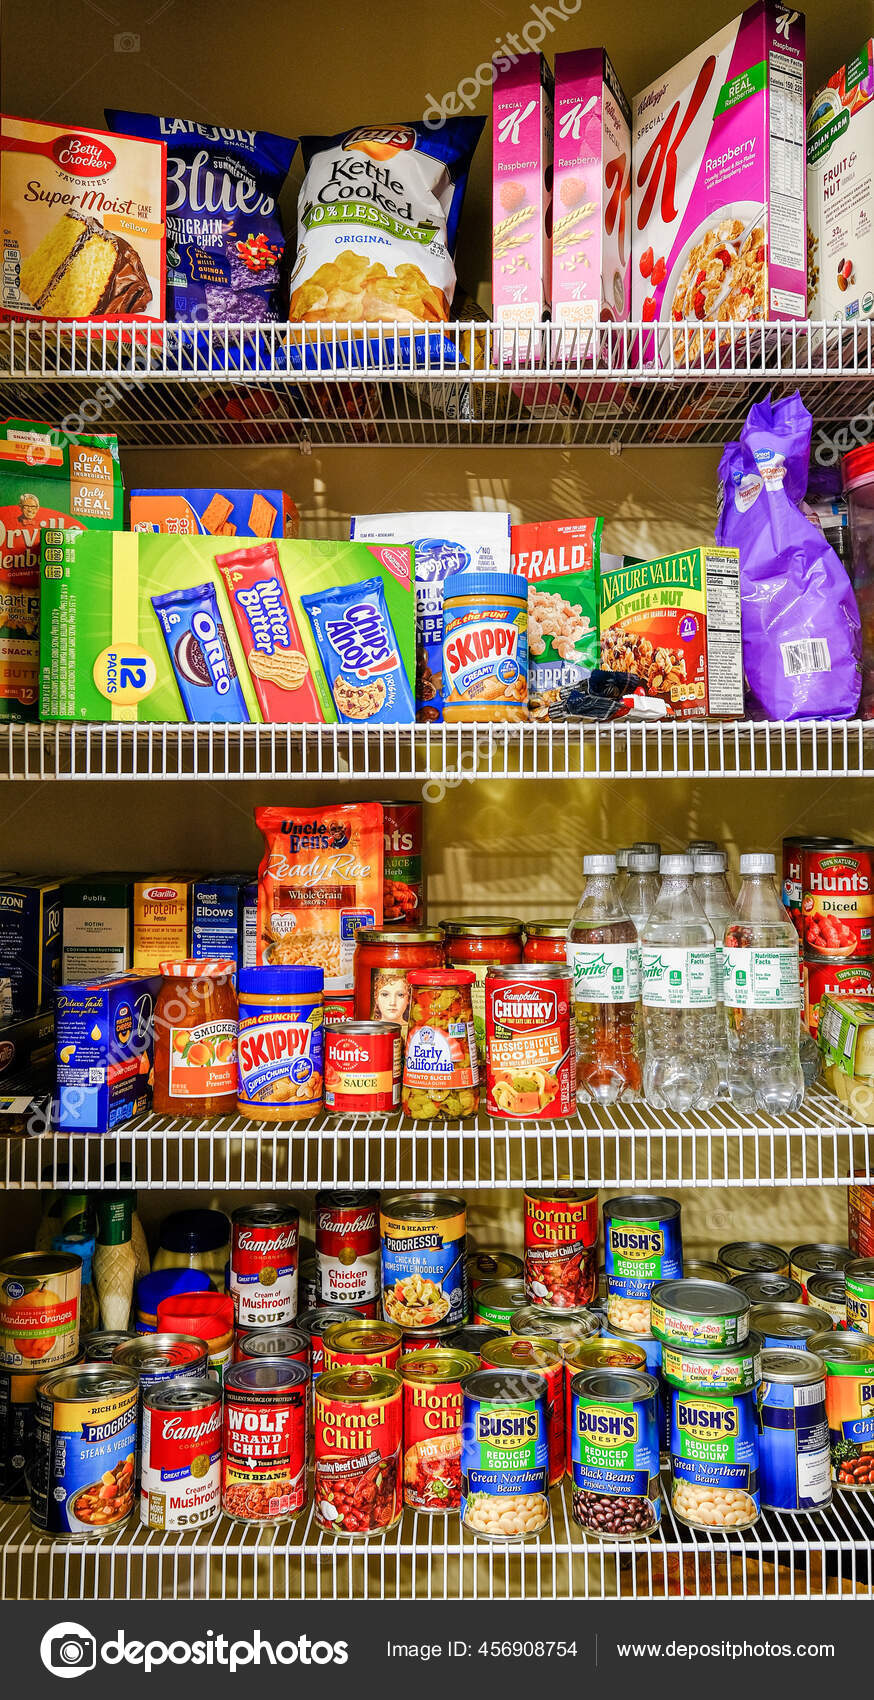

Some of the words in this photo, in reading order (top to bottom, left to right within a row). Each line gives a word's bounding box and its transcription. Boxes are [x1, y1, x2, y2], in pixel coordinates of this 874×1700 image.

[772, 39, 800, 56] Raspberry
[729, 78, 752, 98] REAL
[498, 102, 523, 110] SPECIAL
[559, 97, 584, 105] SPECIAL
[498, 101, 537, 144] K
[559, 96, 598, 140] K
[637, 112, 664, 140] SPECIAL
[830, 116, 848, 136] FARM
[69, 139, 104, 160] Betty
[224, 140, 255, 152] SNACKS
[58, 150, 109, 169] Crocker
[706, 136, 756, 173] Raspberry
[497, 160, 538, 171] Raspberry
[558, 156, 598, 168] Raspberry
[329, 157, 404, 195] Kettle
[823, 157, 847, 187] FRUIT
[57, 171, 108, 187] FAVORITES
[823, 180, 841, 202] NUT
[318, 183, 413, 221] Cooked
[119, 220, 149, 234] Yellow
[342, 204, 390, 226] LESS
[394, 223, 427, 241] FAT
[196, 236, 223, 249] CHIPS
[335, 234, 392, 246] ORIGINAL
[198, 266, 223, 275] QUINOA
[78, 453, 104, 465] Only
[73, 462, 110, 475] REAL
[79, 487, 104, 498] Only
[73, 497, 110, 510] REAL
[602, 566, 649, 603] NATURE
[649, 554, 697, 587] VALLEY
[615, 592, 650, 619] Fruit
[660, 590, 684, 607] NUT
[255, 578, 292, 648] Nutter
[481, 611, 509, 621] FUN!
[236, 589, 275, 655] Butter
[343, 604, 390, 661] Chips
[191, 612, 231, 696] OREO
[446, 628, 516, 674] SKIPPY
[107, 653, 117, 693] PACKS
[120, 657, 147, 689] 12
[462, 664, 494, 686] CREAMY
[384, 673, 400, 711] ORIGINAL
[281, 820, 328, 837] Uncle
[290, 834, 329, 853] Ben's
[833, 858, 859, 869] NATURAL
[265, 854, 330, 888] Ready
[327, 855, 371, 878] Rice
[150, 890, 177, 899] Barilla
[197, 893, 217, 902] Great
[197, 907, 234, 918] Elbows
[822, 901, 858, 911] Diced
[573, 962, 607, 979] Sprite
[85, 996, 103, 1008] Taste
[503, 990, 541, 1001] Campbell's
[494, 1001, 553, 1019] CHUNKY
[258, 1012, 300, 1024] CRUNCHY
[240, 1027, 310, 1073] SKIPPY
[491, 1041, 523, 1054] CLASSIC
[524, 1037, 560, 1050] CHICKEN
[414, 1045, 442, 1061] Early
[492, 1046, 560, 1062] NOODLE
[406, 1057, 454, 1073] California
[209, 1072, 231, 1081] Peach
[343, 1078, 378, 1088] SAUCE
[527, 1202, 587, 1223] Hormel
[319, 1212, 376, 1236] Campbell's
[533, 1223, 577, 1241] Chili
[238, 1229, 296, 1255] Campbell's
[387, 1235, 439, 1251] PROGRESSO
[611, 1231, 661, 1252] BUSH'S
[395, 1256, 421, 1264] CHICKEN
[545, 1248, 558, 1259] Beef
[415, 1265, 444, 1274] NOODLES
[617, 1260, 656, 1270] REDUCED
[328, 1269, 368, 1280] Chicken
[619, 1269, 654, 1278] SODIUM
[329, 1277, 366, 1289] Noodle
[608, 1277, 627, 1288] Great
[254, 1291, 273, 1299] Cream
[330, 1291, 366, 1301] SOUP
[626, 1289, 648, 1298] Beans
[242, 1296, 291, 1310] Mushroom
[39, 1310, 72, 1324] Oranges
[247, 1312, 285, 1323] SOUP
[664, 1317, 693, 1331] Chicken
[705, 1325, 721, 1334] Sea
[671, 1329, 688, 1337] CHUNK
[681, 1363, 713, 1375] Chicken
[725, 1366, 739, 1375] Sea
[91, 1406, 110, 1415] RICH
[316, 1403, 385, 1428] Hormel
[228, 1408, 289, 1432] WOLF
[578, 1411, 635, 1437] BUSH'S
[678, 1406, 736, 1431] BUSH'S
[479, 1416, 536, 1437] BUSH'S
[692, 1429, 719, 1437] BEST
[231, 1432, 282, 1444] BRAND
[322, 1427, 372, 1450] Chili
[591, 1435, 618, 1443] BEST
[233, 1442, 280, 1456] CHILI
[420, 1445, 438, 1457] HOT
[584, 1446, 629, 1459] REDUCED
[685, 1440, 729, 1452] REDUCED
[80, 1447, 105, 1460] STEAK
[486, 1450, 531, 1460] REDUCED
[687, 1449, 726, 1460] SODIUM
[334, 1460, 351, 1472] Beef
[488, 1459, 529, 1469] SODIUM
[586, 1456, 626, 1467] SODIUM
[674, 1459, 695, 1471] Great
[698, 1464, 747, 1476] Northern
[228, 1469, 250, 1480] WITH
[251, 1470, 287, 1481] BEANS
[471, 1472, 498, 1483] Great
[500, 1471, 544, 1482] Northern
[580, 1466, 604, 1481] Black
[606, 1470, 635, 1483] Beans
[695, 1475, 719, 1485] Beans
[185, 1486, 207, 1496] Cream
[497, 1484, 522, 1493] Beans
[583, 1480, 605, 1491] Frijoles
[169, 1488, 220, 1510] Mushroom
[177, 1505, 216, 1526] SOUP
